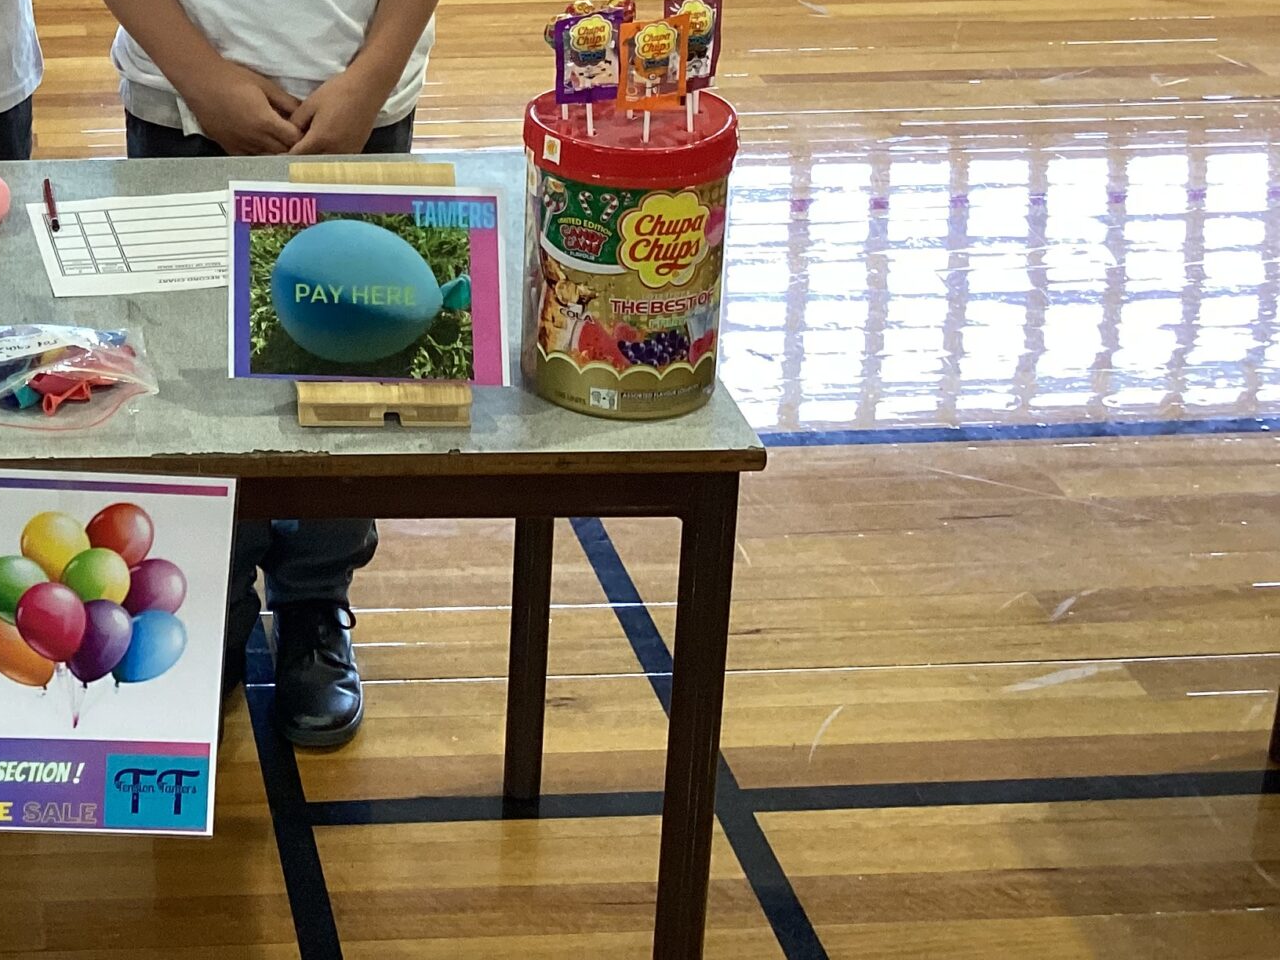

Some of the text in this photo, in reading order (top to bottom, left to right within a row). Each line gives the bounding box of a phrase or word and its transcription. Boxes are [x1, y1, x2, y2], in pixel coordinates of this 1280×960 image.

[412, 199, 495, 229] TAMERS
[634, 213, 706, 237] Chupa
[583, 219, 613, 237] EDITION
[628, 237, 701, 275] Chups
[294, 283, 416, 307] PAY HERE
[609, 298, 649, 315] THE
[649, 295, 697, 315] BEST
[559, 307, 594, 324] COLA
[23, 802, 97, 824] SALE
